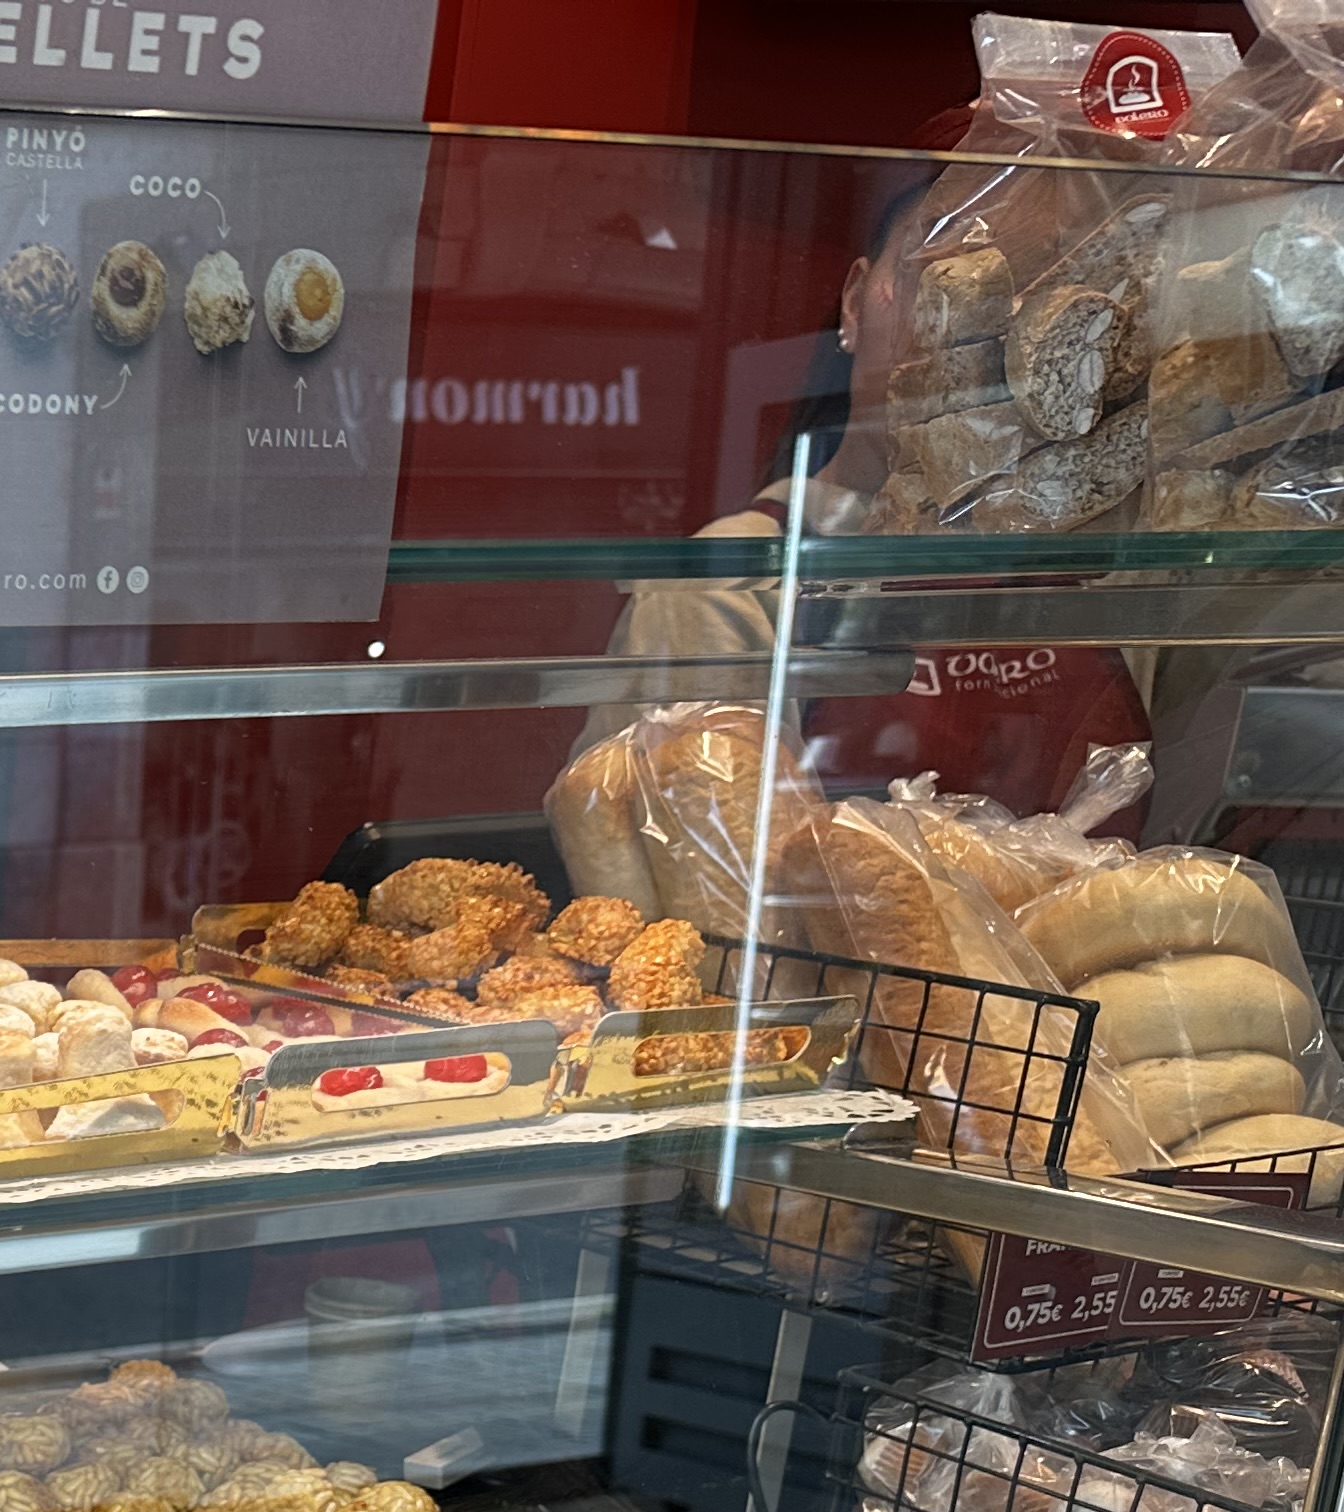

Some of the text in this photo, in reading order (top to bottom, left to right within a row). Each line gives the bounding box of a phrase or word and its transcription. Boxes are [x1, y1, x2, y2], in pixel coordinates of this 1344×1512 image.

[5, 125, 86, 152] PINYÓ
[6, 152, 84, 170] CASTELLA
[129, 175, 202, 199] COCO
[246, 427, 348, 448] VAINILLA
[1004, 1301, 1064, 1333] 0,75€
[1071, 1290, 1120, 1322] 2,55
[1139, 1285, 1251, 1315] 0,75€ 2,55€
